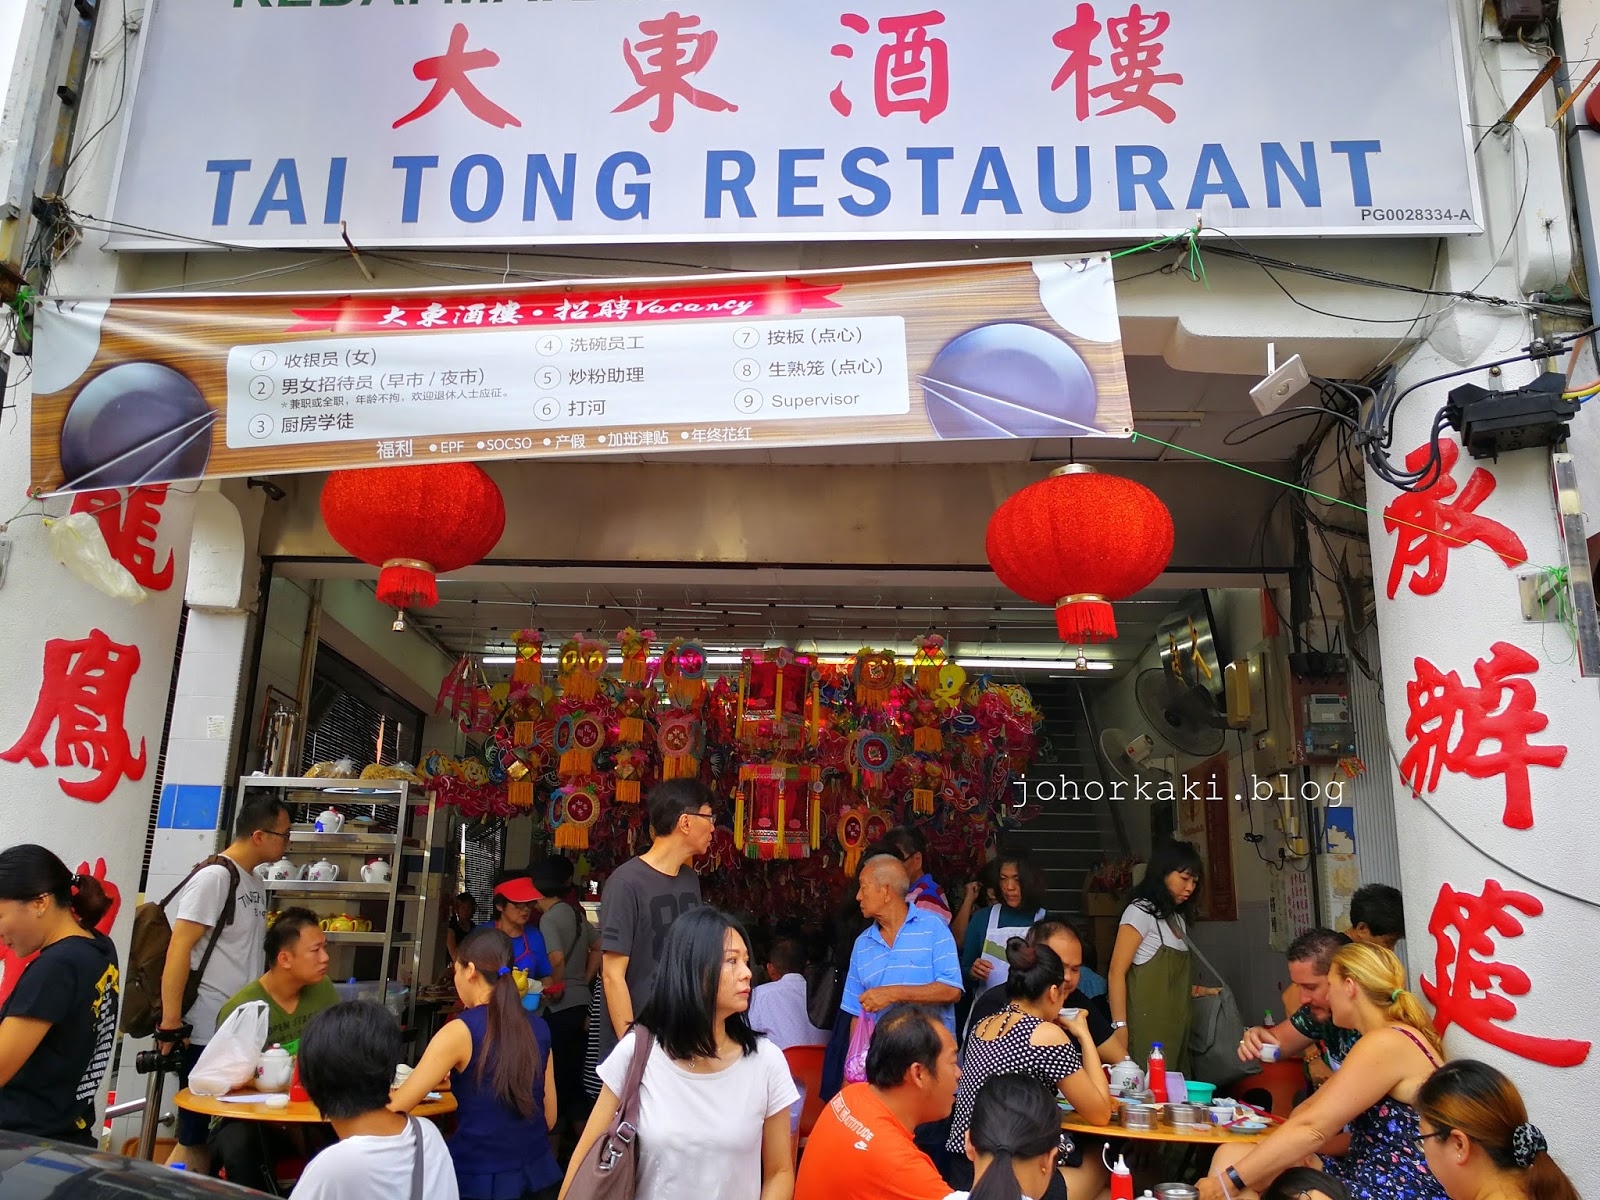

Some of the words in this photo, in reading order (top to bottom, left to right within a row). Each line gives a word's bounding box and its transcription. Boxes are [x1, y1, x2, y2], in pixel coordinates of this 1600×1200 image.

[392, 3, 1183, 133] 大東酒樓
[206, 157, 347, 226] TAI
[392, 151, 651, 223] TONG
[704, 140, 1381, 220] RESTAURANT
[1360, 207, 1472, 223] PG0028334-A
[635, 298, 755, 316] Vacancy
[569, 335, 645, 353] 洗碗员工
[767, 329, 805, 346] 按板
[284, 352, 339, 369] 收银员
[768, 360, 825, 378] 生熟笼
[568, 366, 645, 385] 炒粉助理
[281, 376, 373, 395] 男女招待员
[568, 399, 607, 417] 打河
[771, 393, 860, 410] Supervisor
[281, 412, 354, 434] 厨房学徒
[376, 439, 414, 461] 福利
[440, 440, 465, 454] EPF
[486, 436, 533, 452] SOCSO
[554, 433, 587, 450] 产假
[607, 429, 670, 448] 加班津贴
[691, 426, 753, 443] 年终花红
